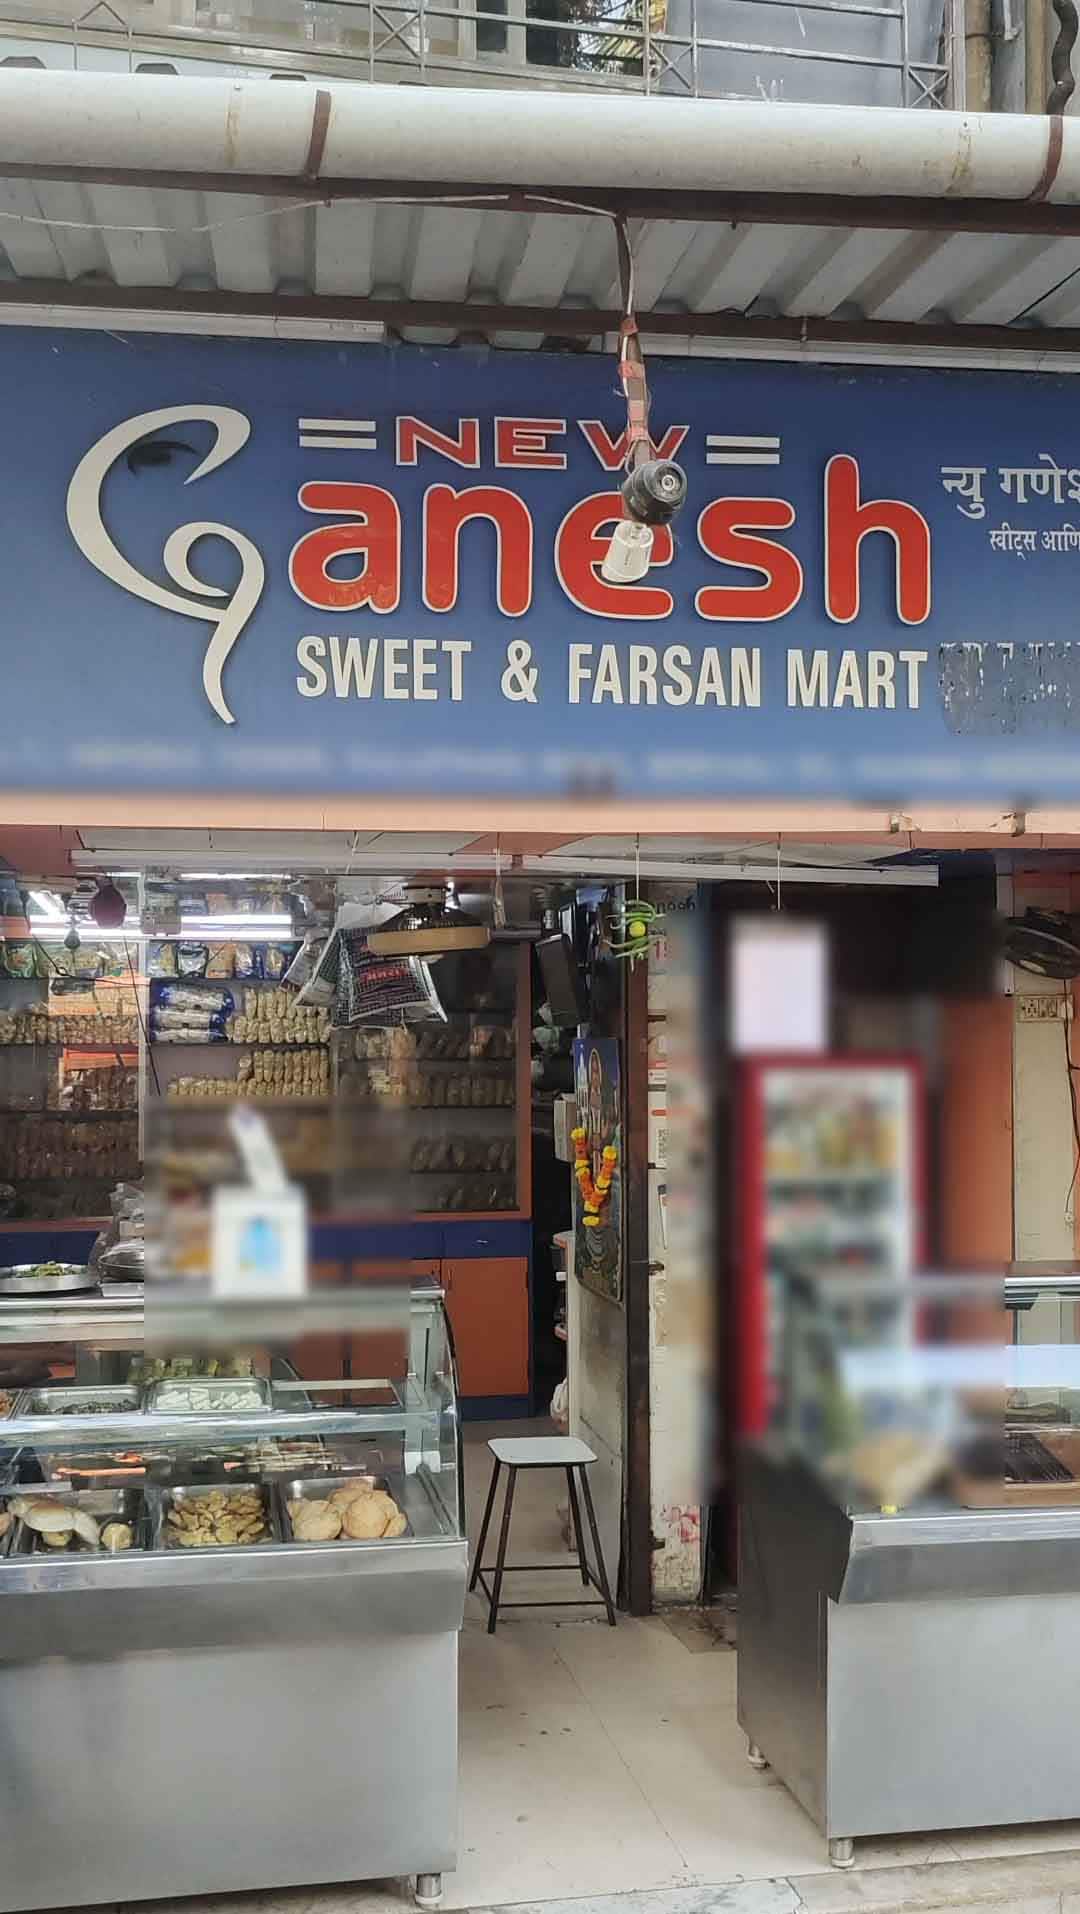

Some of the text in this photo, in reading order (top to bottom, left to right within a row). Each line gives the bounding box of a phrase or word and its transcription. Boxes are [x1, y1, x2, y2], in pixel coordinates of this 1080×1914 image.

[396, 416, 690, 471] NEW
[296, 635, 472, 701] SWEET
[500, 639, 538, 703] &
[568, 642, 761, 708] FARSAN
[786, 648, 928, 709] MART
